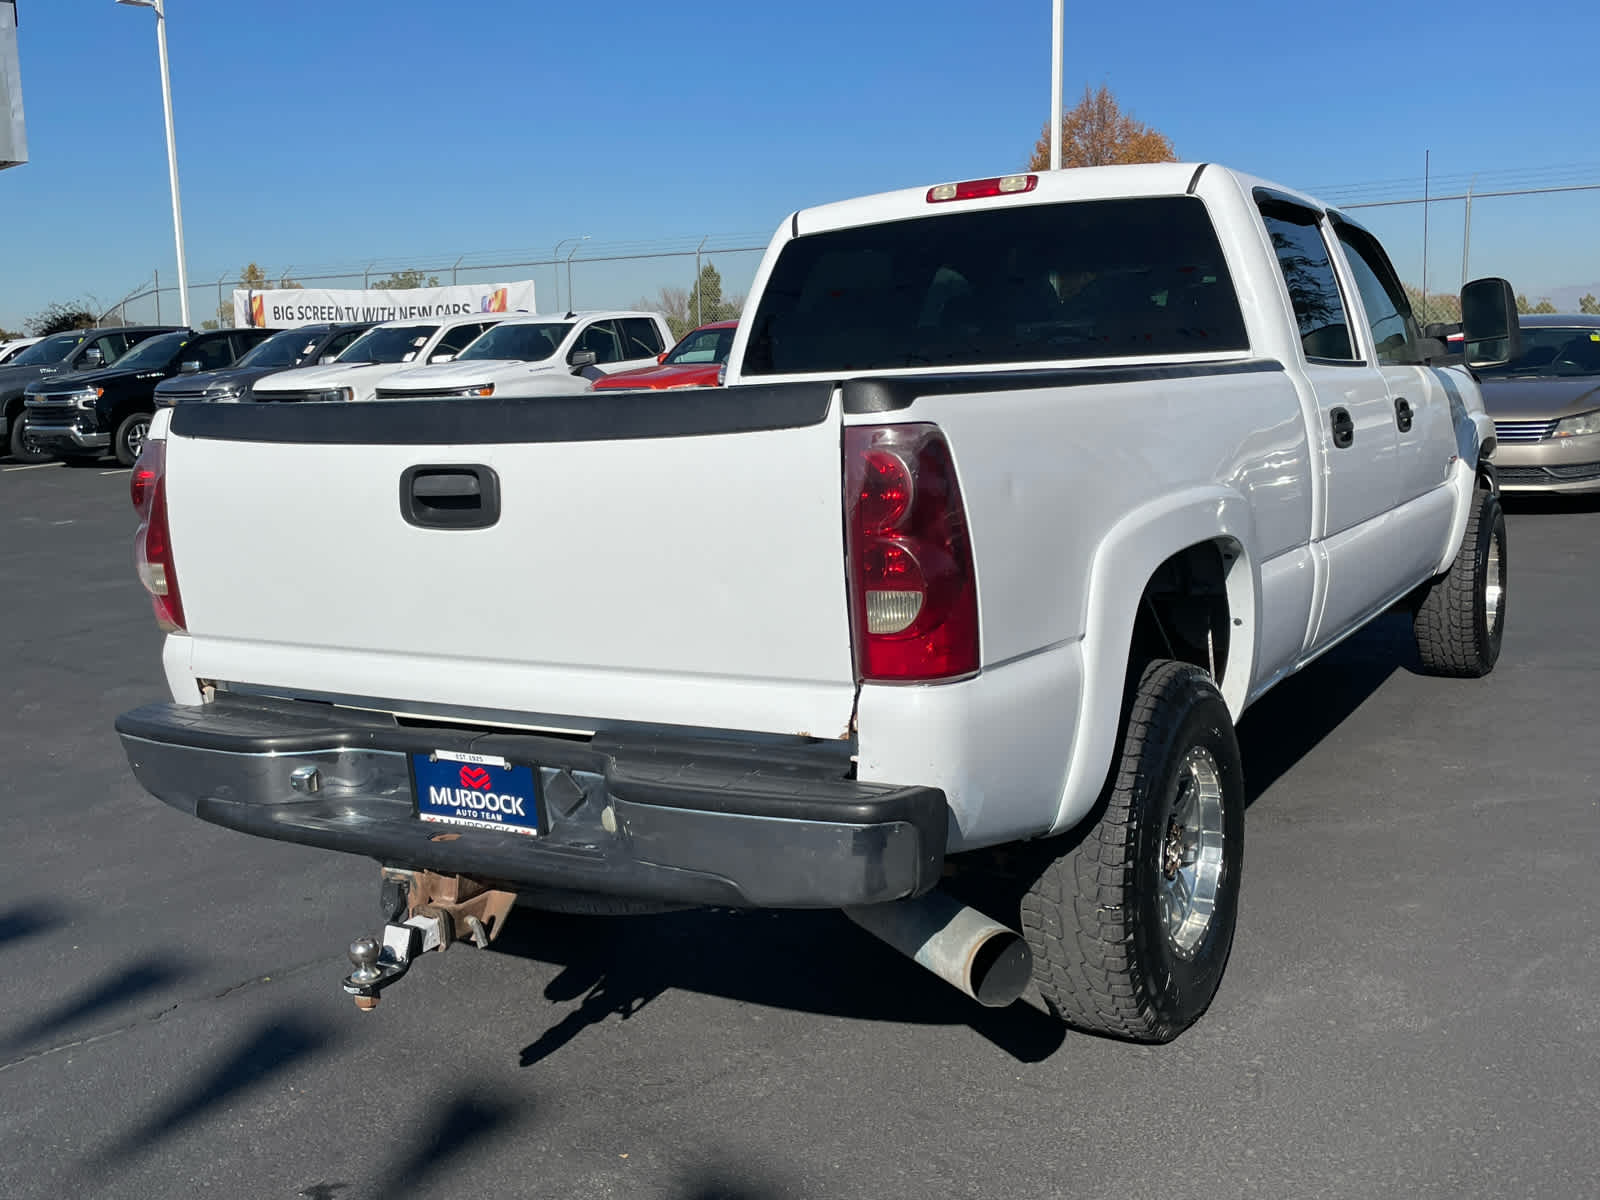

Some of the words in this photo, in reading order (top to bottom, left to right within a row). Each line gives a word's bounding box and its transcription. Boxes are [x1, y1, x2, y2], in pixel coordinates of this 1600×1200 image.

[273, 305, 294, 320] BIG
[297, 305, 344, 321] SCREEN
[345, 306, 359, 321] TV
[362, 306, 396, 322] WITH
[400, 305, 432, 320] NEW
[436, 303, 471, 316] CARS
[429, 785, 525, 817] MURDOCK
[456, 808, 478, 817] AUTO
[481, 811, 502, 821] TEAM
